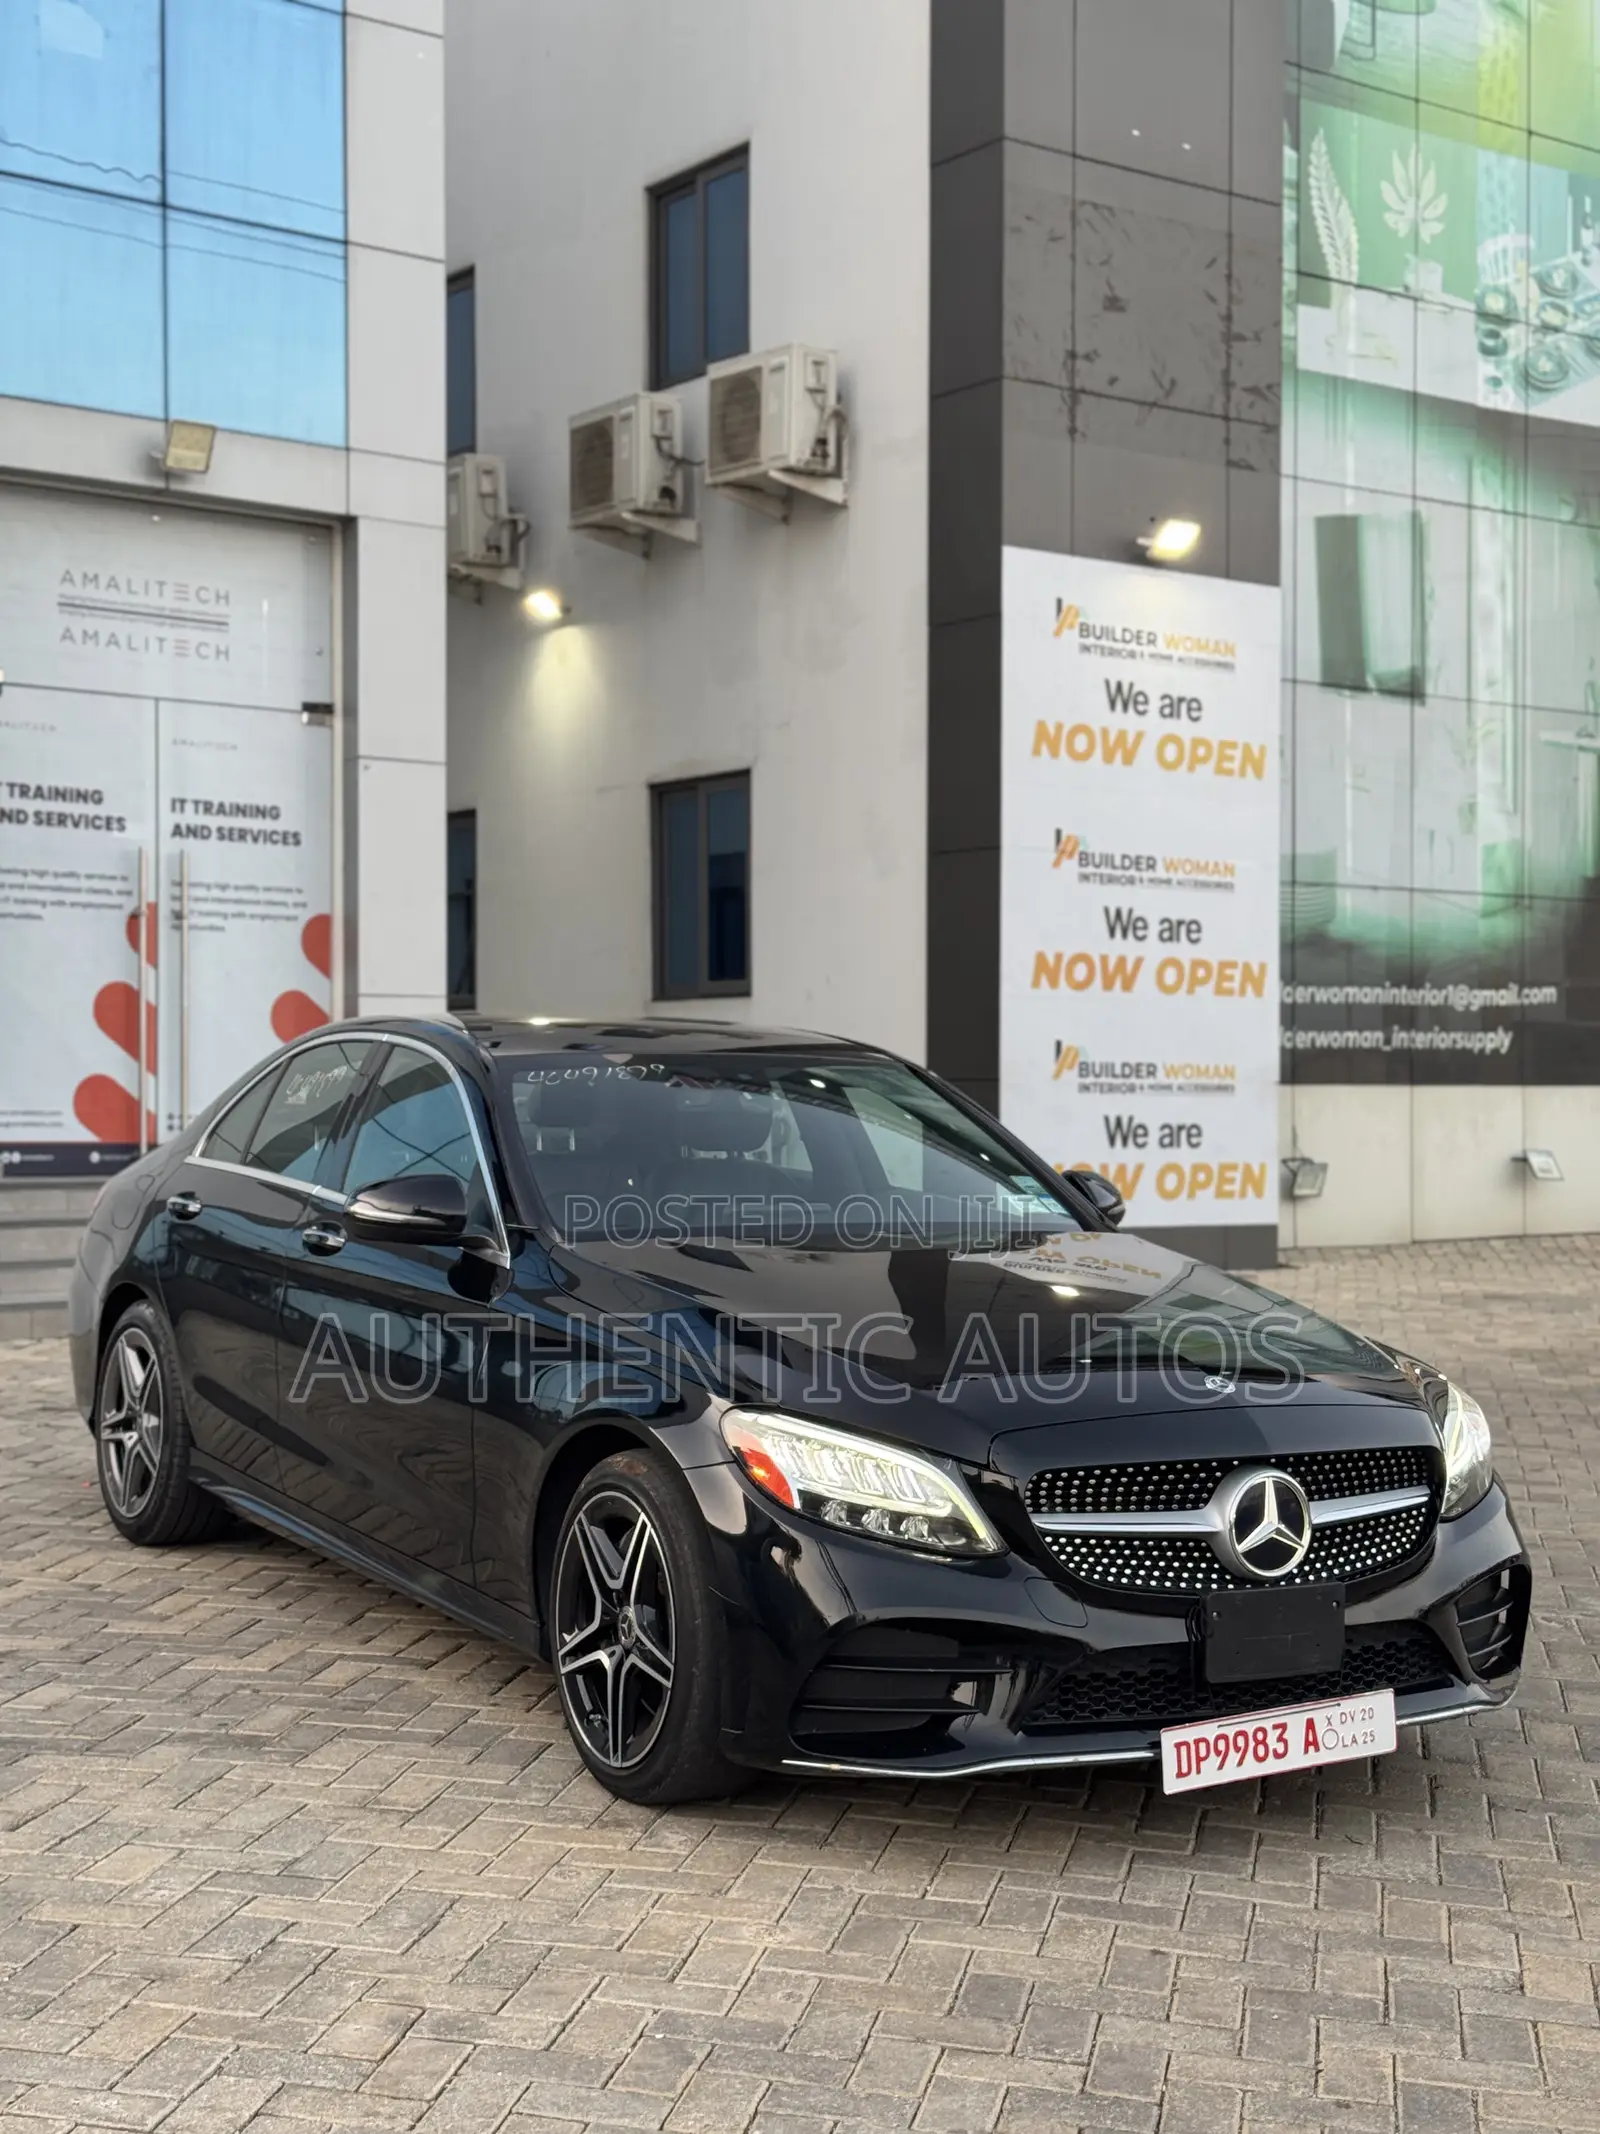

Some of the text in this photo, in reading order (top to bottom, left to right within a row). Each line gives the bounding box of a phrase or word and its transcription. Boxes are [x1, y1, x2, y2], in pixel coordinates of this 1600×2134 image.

[59, 568, 231, 607] AMALITECH
[59, 625, 231, 663] AMALITECH
[1078, 621, 1237, 658] BUILDER WOMAN
[1078, 642, 1137, 660] INTERIOR
[1104, 677, 1203, 723] We are
[1031, 718, 1268, 781] NOW OPEN
[6, 781, 104, 805] TRAINING
[0, 806, 127, 833] ND SERVICES
[170, 797, 281, 821] IT TRAINING
[170, 823, 302, 848] AND SERVICES
[1077, 851, 1236, 878] BUILDER WOMAN
[1077, 872, 1136, 887] INTERIOR
[1104, 906, 1203, 944] We are
[1031, 950, 1268, 999] NOW OPEN
[1077, 1061, 1236, 1080] BUILDER WOMAN
[1077, 1082, 1136, 1094] INTERIOR
[1103, 1114, 1203, 1149] We are
[1155, 1161, 1268, 1202] OPEN
[1339, 1709, 1356, 1725] DV
[1359, 1706, 1375, 1721] 20
[1173, 1716, 1321, 1779] DP9983 A
[1341, 1730, 1376, 1749] LA 25
